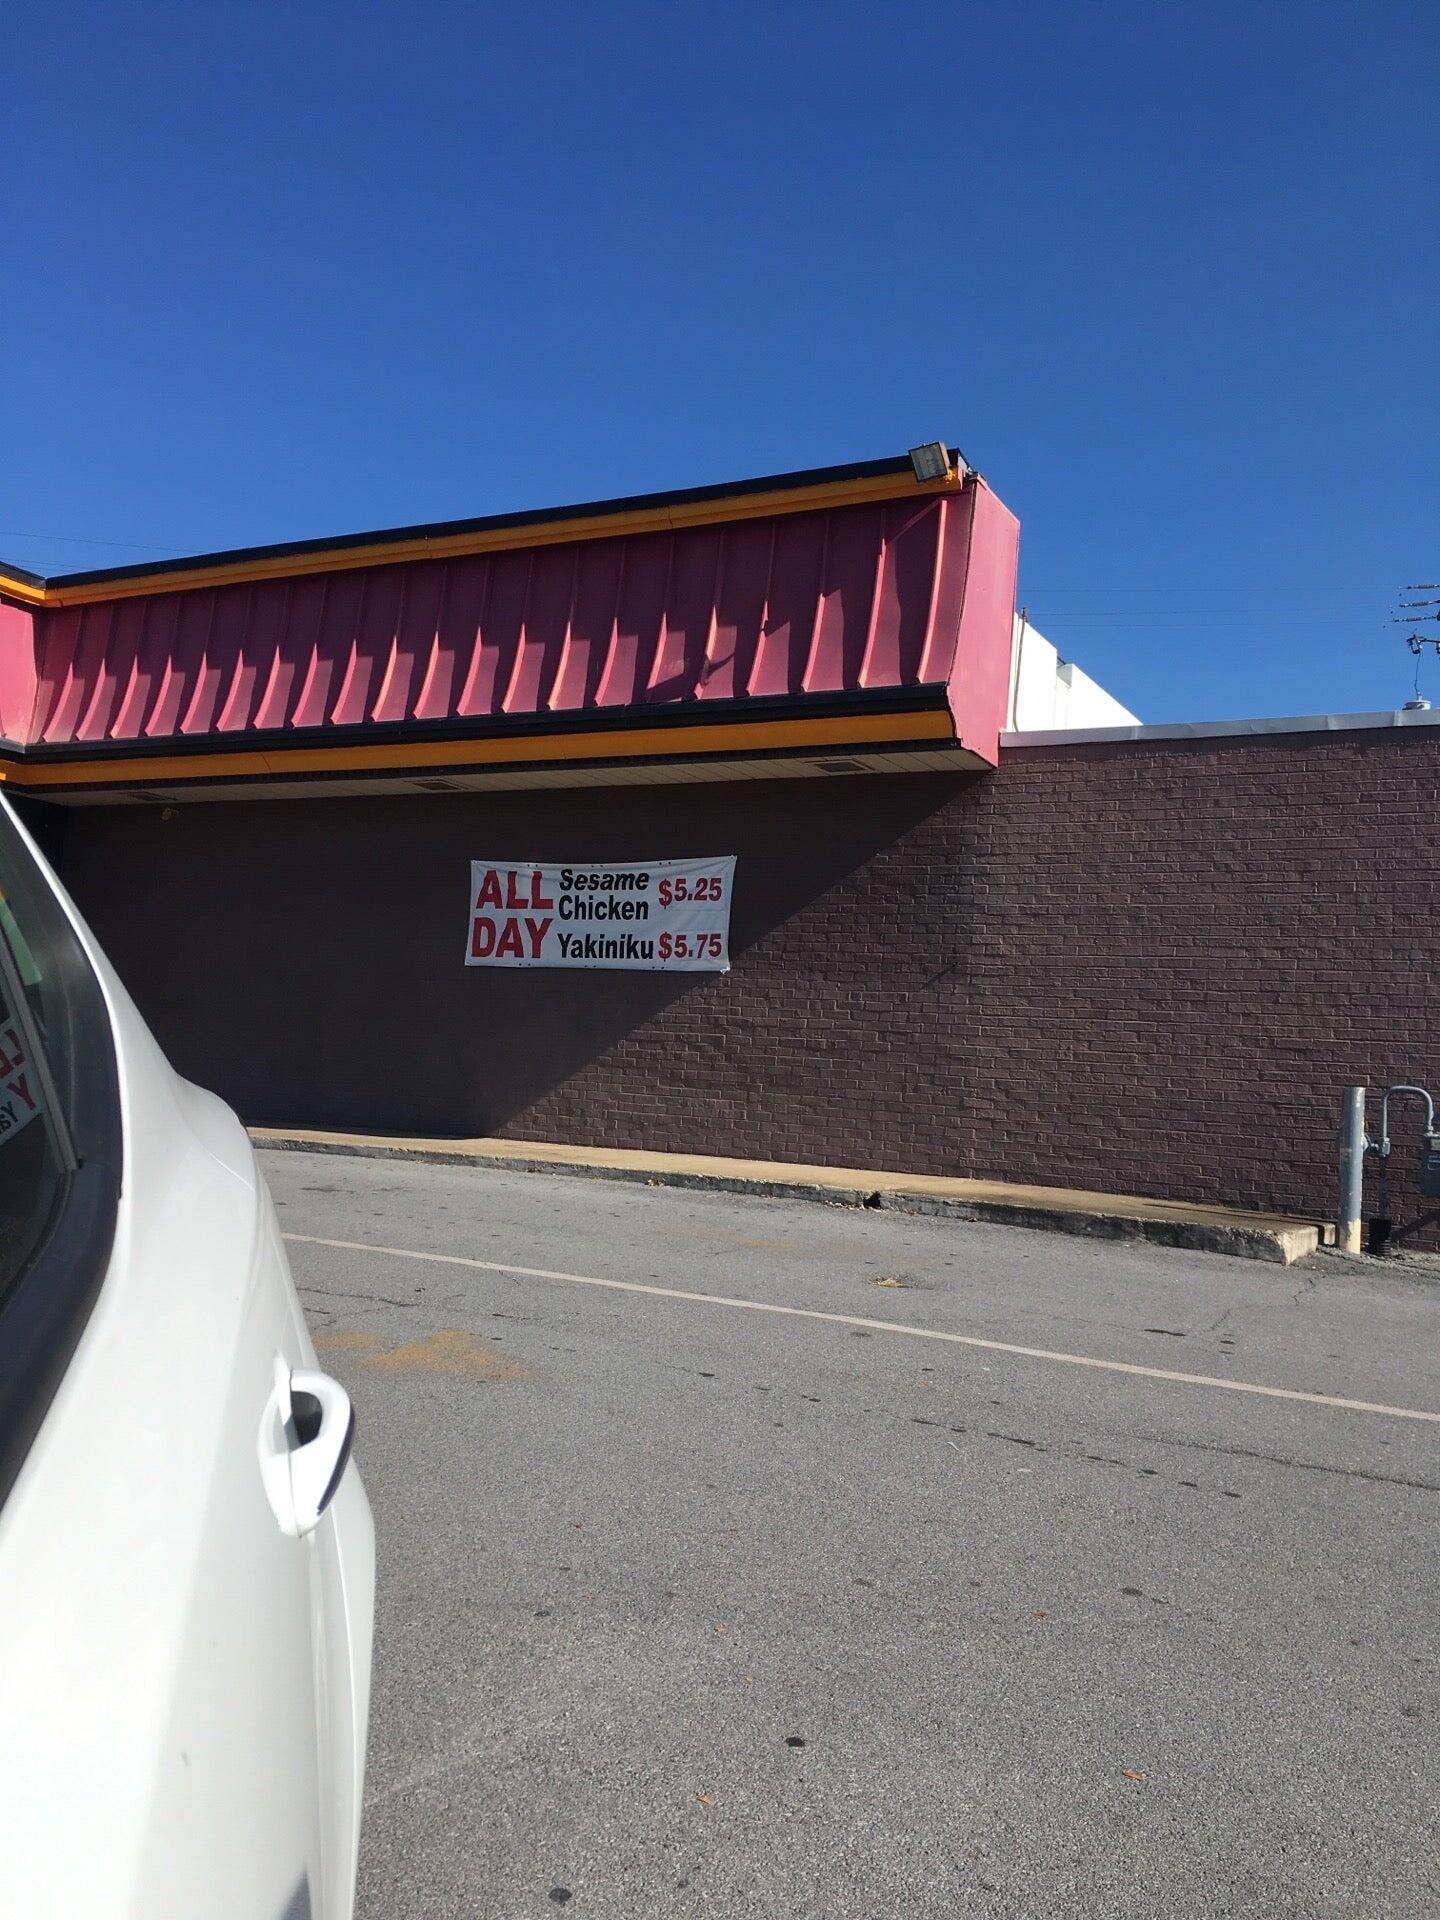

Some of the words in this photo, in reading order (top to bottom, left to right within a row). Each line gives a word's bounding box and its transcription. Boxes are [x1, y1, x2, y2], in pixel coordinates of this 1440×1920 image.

[476, 870, 553, 909] ALL
[559, 869, 650, 891] Sesame
[658, 878, 722, 909] $5.25
[558, 895, 649, 921] Chicken
[471, 917, 553, 958] DAY
[557, 932, 654, 960] Yakiniku
[658, 932, 722, 962] $5.75
